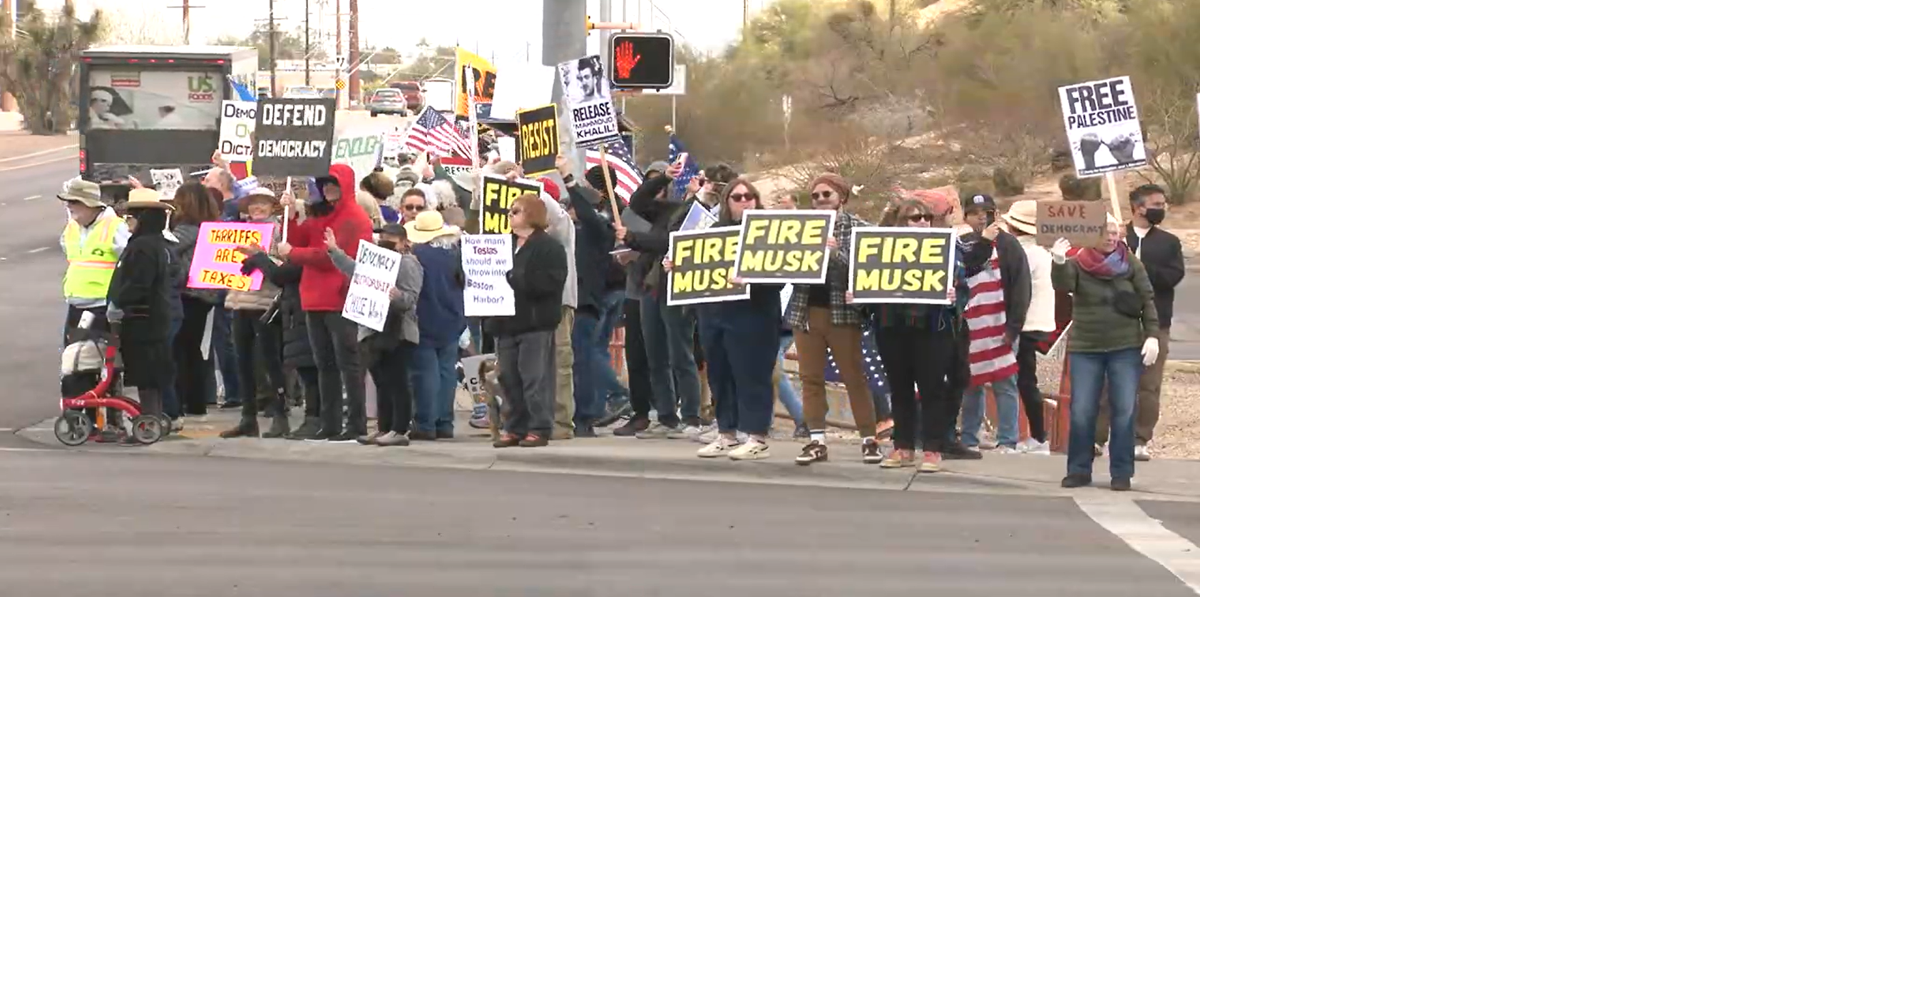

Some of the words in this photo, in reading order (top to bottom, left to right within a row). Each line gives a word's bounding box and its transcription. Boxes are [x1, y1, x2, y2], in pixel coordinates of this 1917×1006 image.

[1066, 79, 1129, 114] FREE
[262, 103, 326, 126] DEFEND
[573, 102, 611, 122] RELEASE
[1068, 106, 1136, 130] PALESTINE
[521, 119, 555, 160] RESIST
[576, 124, 615, 139] KHALIL!
[258, 140, 326, 157] DEMOCRACY
[485, 182, 538, 209] FIR
[1047, 205, 1086, 219] SAVE
[211, 229, 260, 244] TARRIFFS
[465, 237, 481, 245] How
[484, 238, 506, 246] many
[745, 220, 826, 245] FIRE
[215, 248, 238, 263] ARE
[473, 246, 498, 255] Teslas
[741, 249, 823, 272] MUSK
[858, 237, 946, 264] FIRE
[202, 269, 246, 289] TAXES
[468, 268, 490, 276] throw
[855, 269, 945, 292] MUSK
[467, 279, 494, 290] Boston
[473, 295, 504, 304] Harbor?
